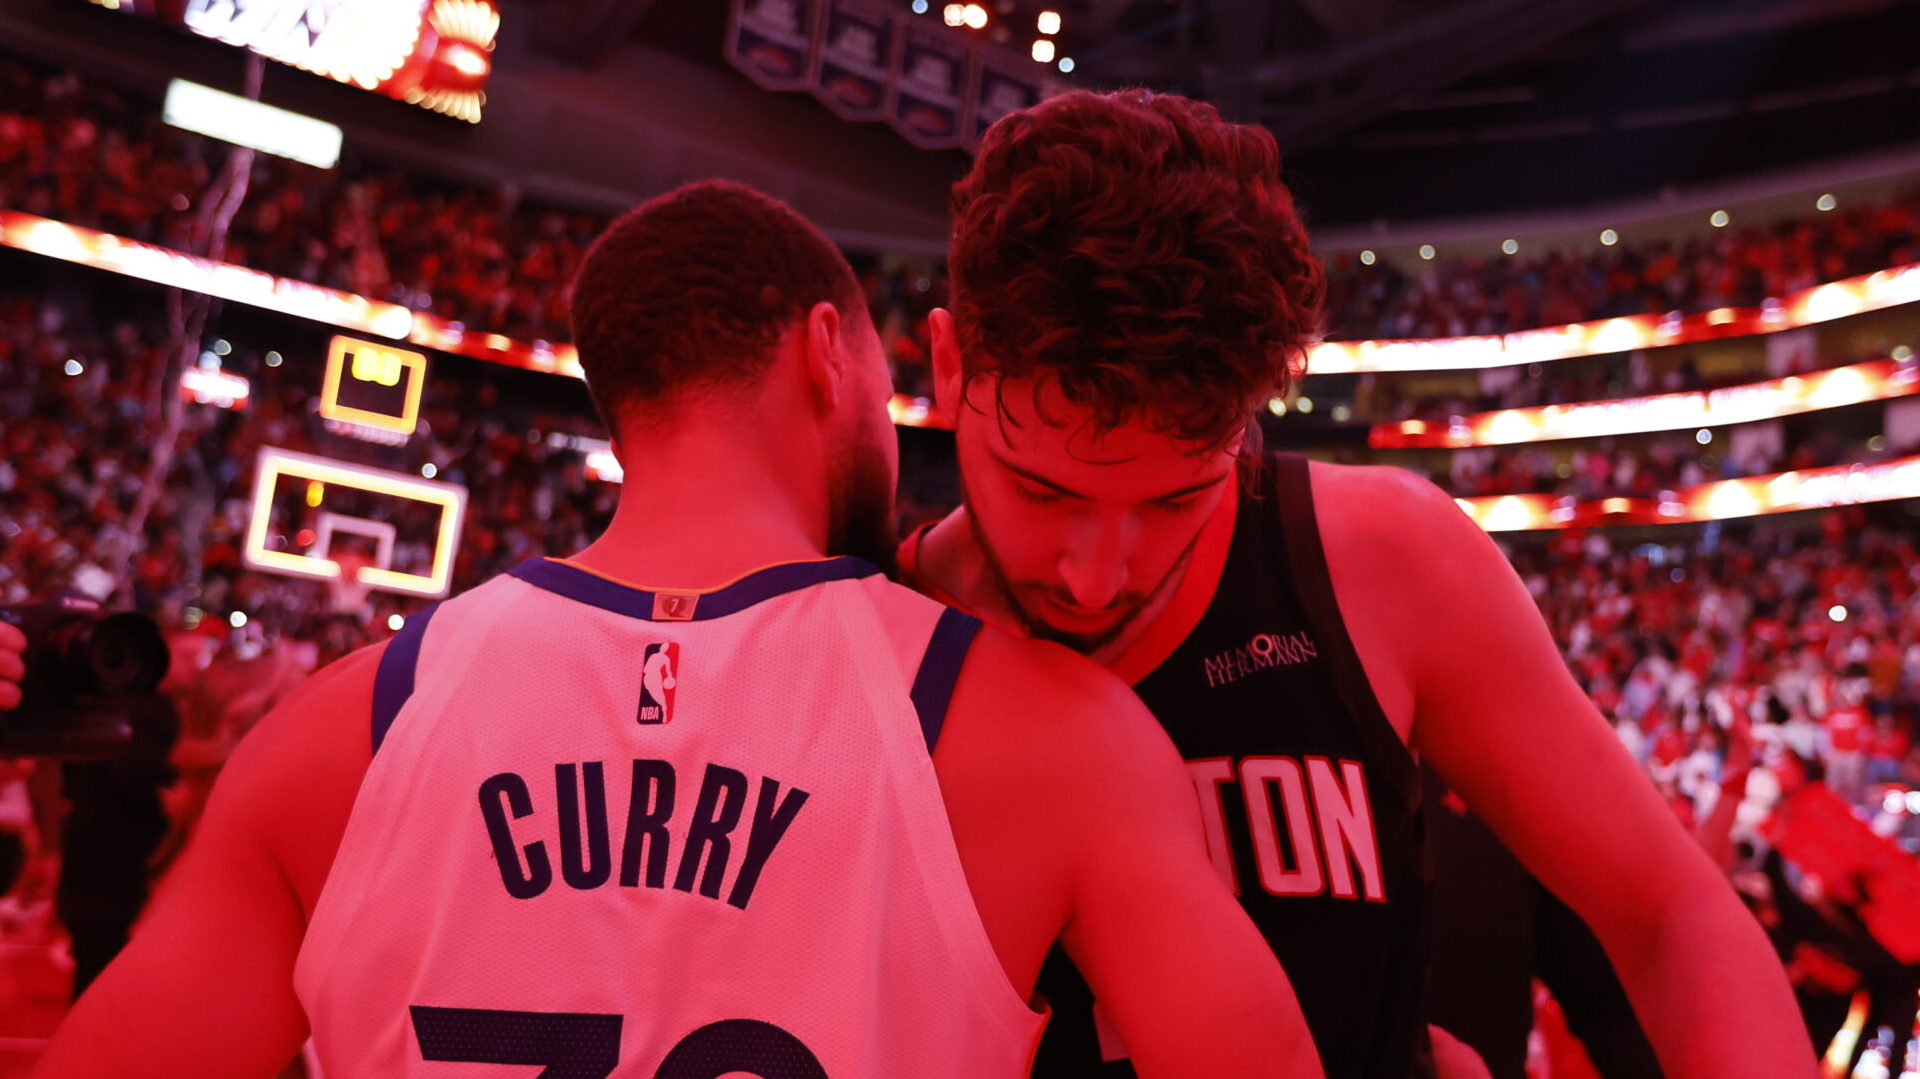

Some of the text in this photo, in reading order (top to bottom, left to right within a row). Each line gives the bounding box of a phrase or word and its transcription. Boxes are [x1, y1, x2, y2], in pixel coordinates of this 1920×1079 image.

[669, 598, 680, 613] 7
[1204, 630, 1314, 671] MEMORIAL
[1206, 642, 1318, 687] HERMANN
[641, 706, 660, 721] NBA
[478, 759, 810, 911] CURRY
